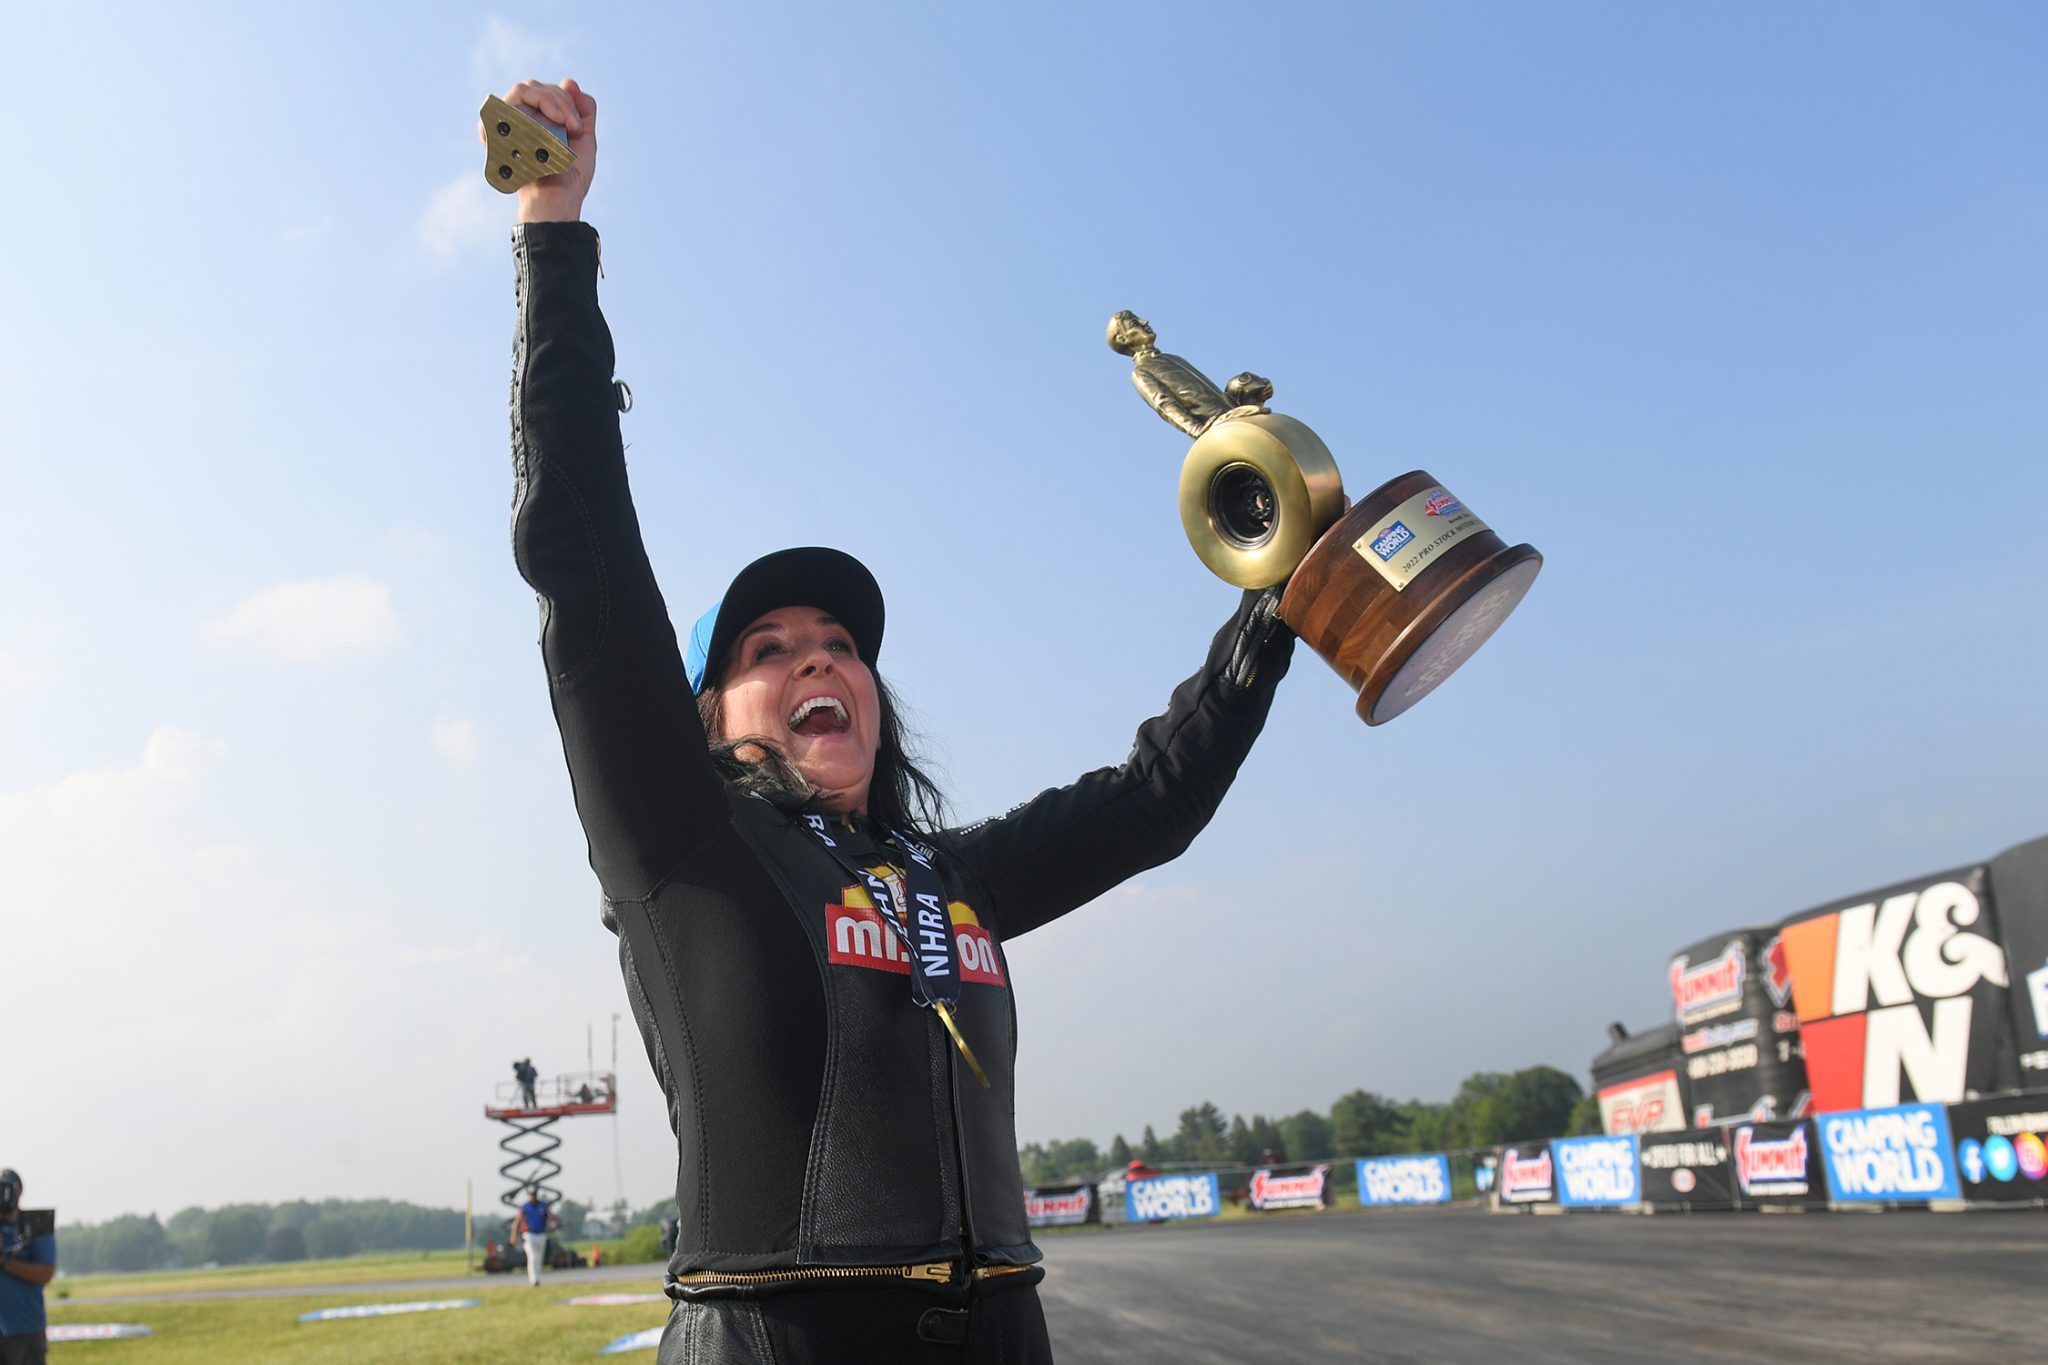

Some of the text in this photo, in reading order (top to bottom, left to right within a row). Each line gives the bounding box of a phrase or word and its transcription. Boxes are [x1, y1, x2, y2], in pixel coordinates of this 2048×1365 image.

[1374, 525, 1405, 551] CAMPING
[1379, 529, 1410, 557] WORLD
[1402, 556, 1420, 573] 2022
[1419, 545, 1435, 560] PRO
[1435, 529, 1457, 547] STOCK
[802, 814, 837, 847] RA
[916, 893, 950, 978] NHRA
[1826, 1111, 1938, 1154] CAMPING
[1559, 1140, 1634, 1169] CAMPING
[1562, 1168, 1635, 1200] WORLD
[1832, 1149, 1944, 1194] WORLD
[1131, 1176, 1211, 1200] CAMPING
[1366, 1177, 1444, 1202] WORLD
[1134, 1194, 1213, 1218] WORLD
